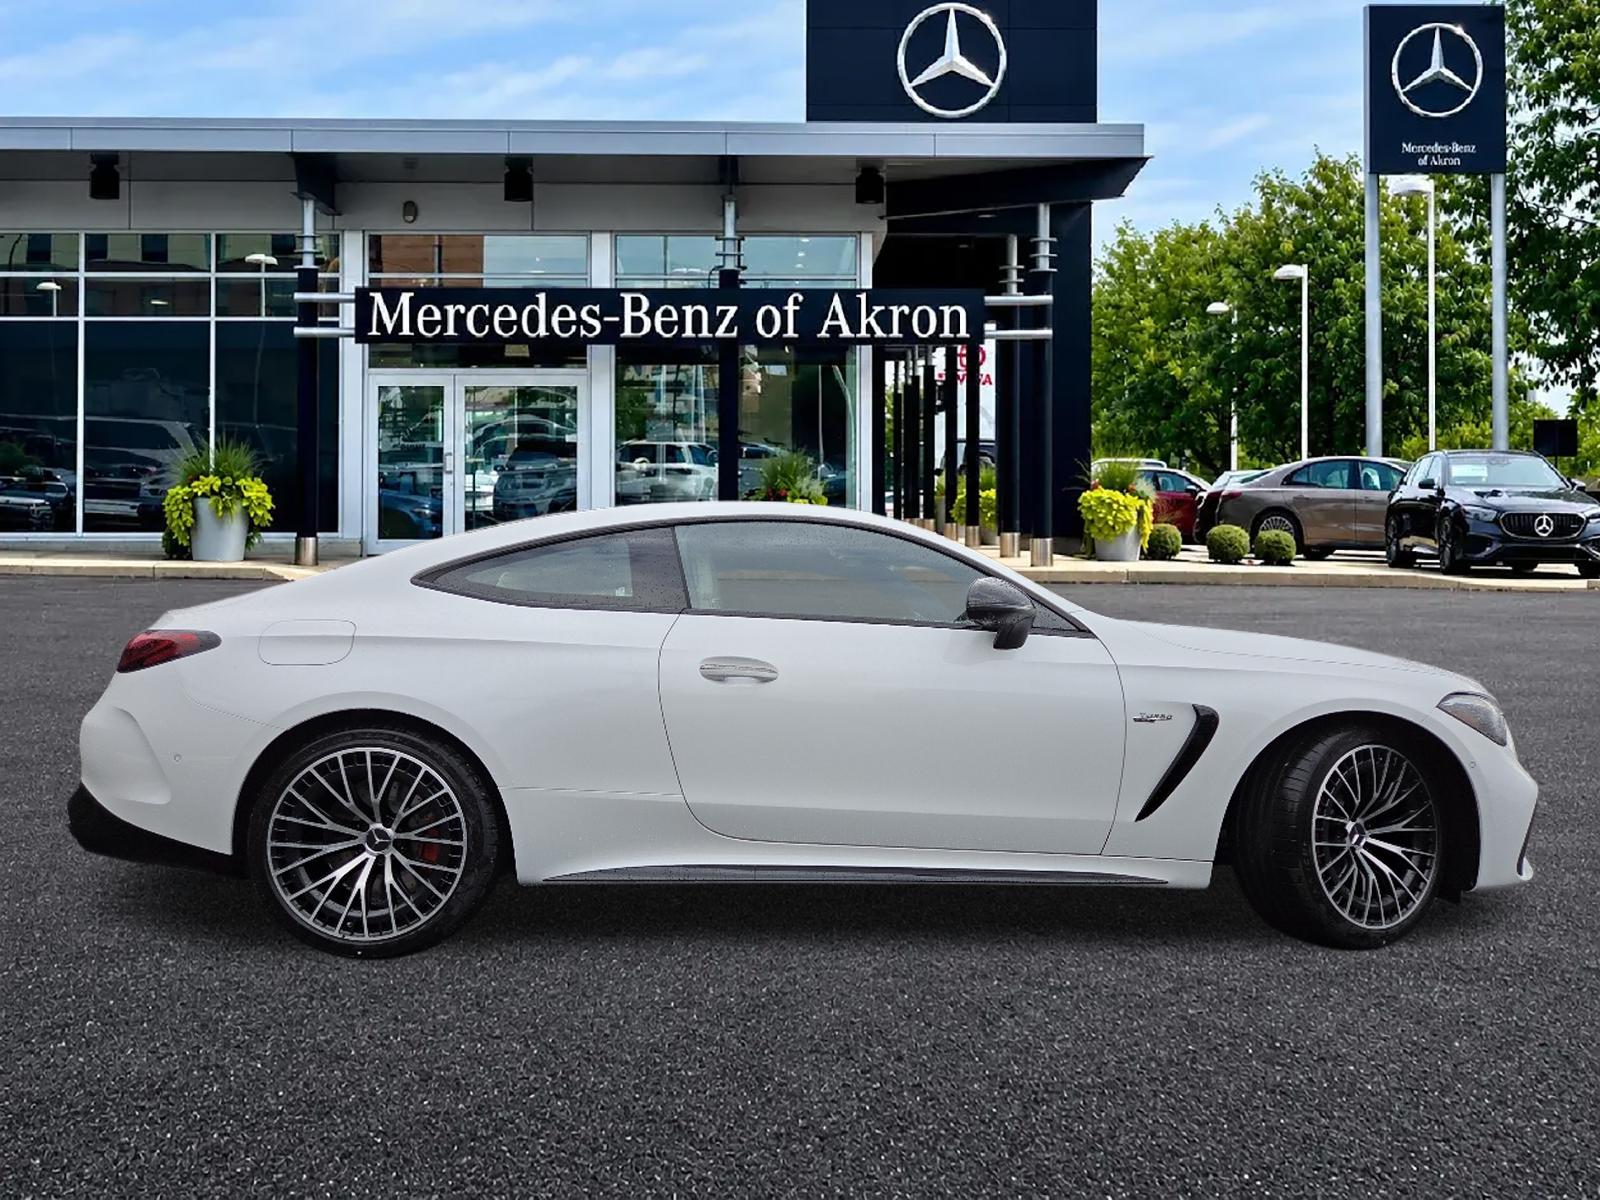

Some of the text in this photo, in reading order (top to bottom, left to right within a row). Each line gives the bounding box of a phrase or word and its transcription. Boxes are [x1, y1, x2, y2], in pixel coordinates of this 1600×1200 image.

[1401, 141, 1476, 153] Mercedes-Benz
[1417, 154, 1461, 166] of Akron
[367, 292, 970, 338] Mercedes-Benz of Akron
